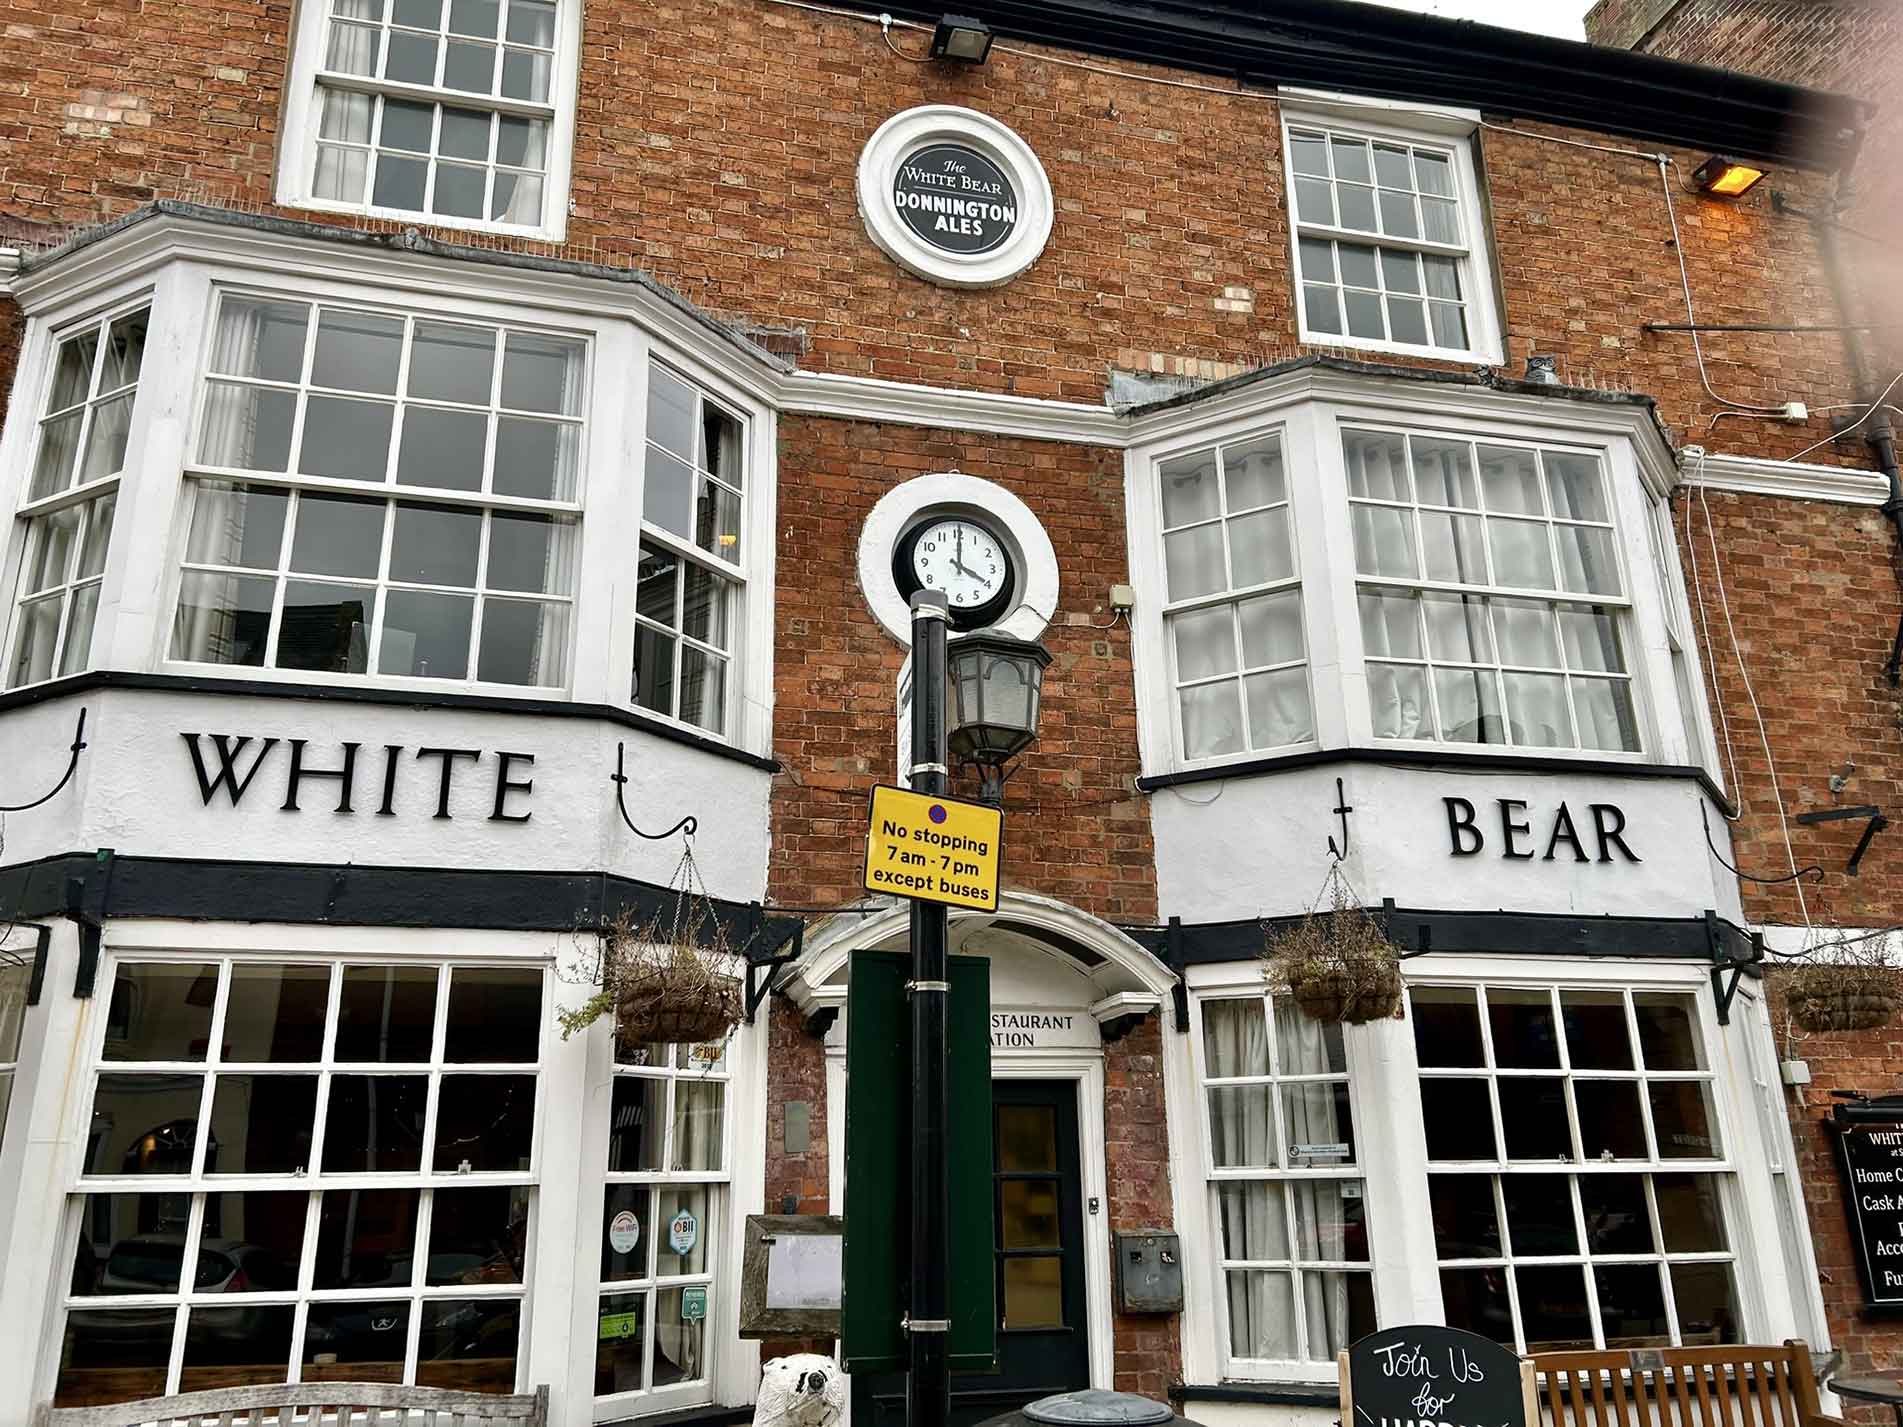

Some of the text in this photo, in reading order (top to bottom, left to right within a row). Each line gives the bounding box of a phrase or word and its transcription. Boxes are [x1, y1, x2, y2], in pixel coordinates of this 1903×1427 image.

[943, 160, 967, 174] The
[904, 166, 1003, 195] WHITE BEAR
[895, 190, 1016, 223] DONNINGTON
[934, 215, 984, 236] ALES
[923, 542, 936, 553] 10
[984, 548, 993, 558] 2
[920, 557, 929, 567] 9
[989, 564, 997, 574] 3
[926, 574, 934, 584] 8
[955, 592, 964, 603] 6
[973, 590, 980, 600] 5
[179, 732, 535, 823] WHITE
[1441, 797, 1644, 863] BEAR
[882, 820, 988, 857] No stopping
[873, 869, 990, 900] except buses
[990, 1032, 1035, 1047] TION
[1868, 1132, 1903, 1145] WHIT
[1855, 1168, 1894, 1183] Home
[1863, 1194, 1895, 1211] Cask
[1884, 1270, 1903, 1287] Fu
[1373, 1341, 1485, 1384] Join Us
[1411, 1381, 1456, 1417] for
